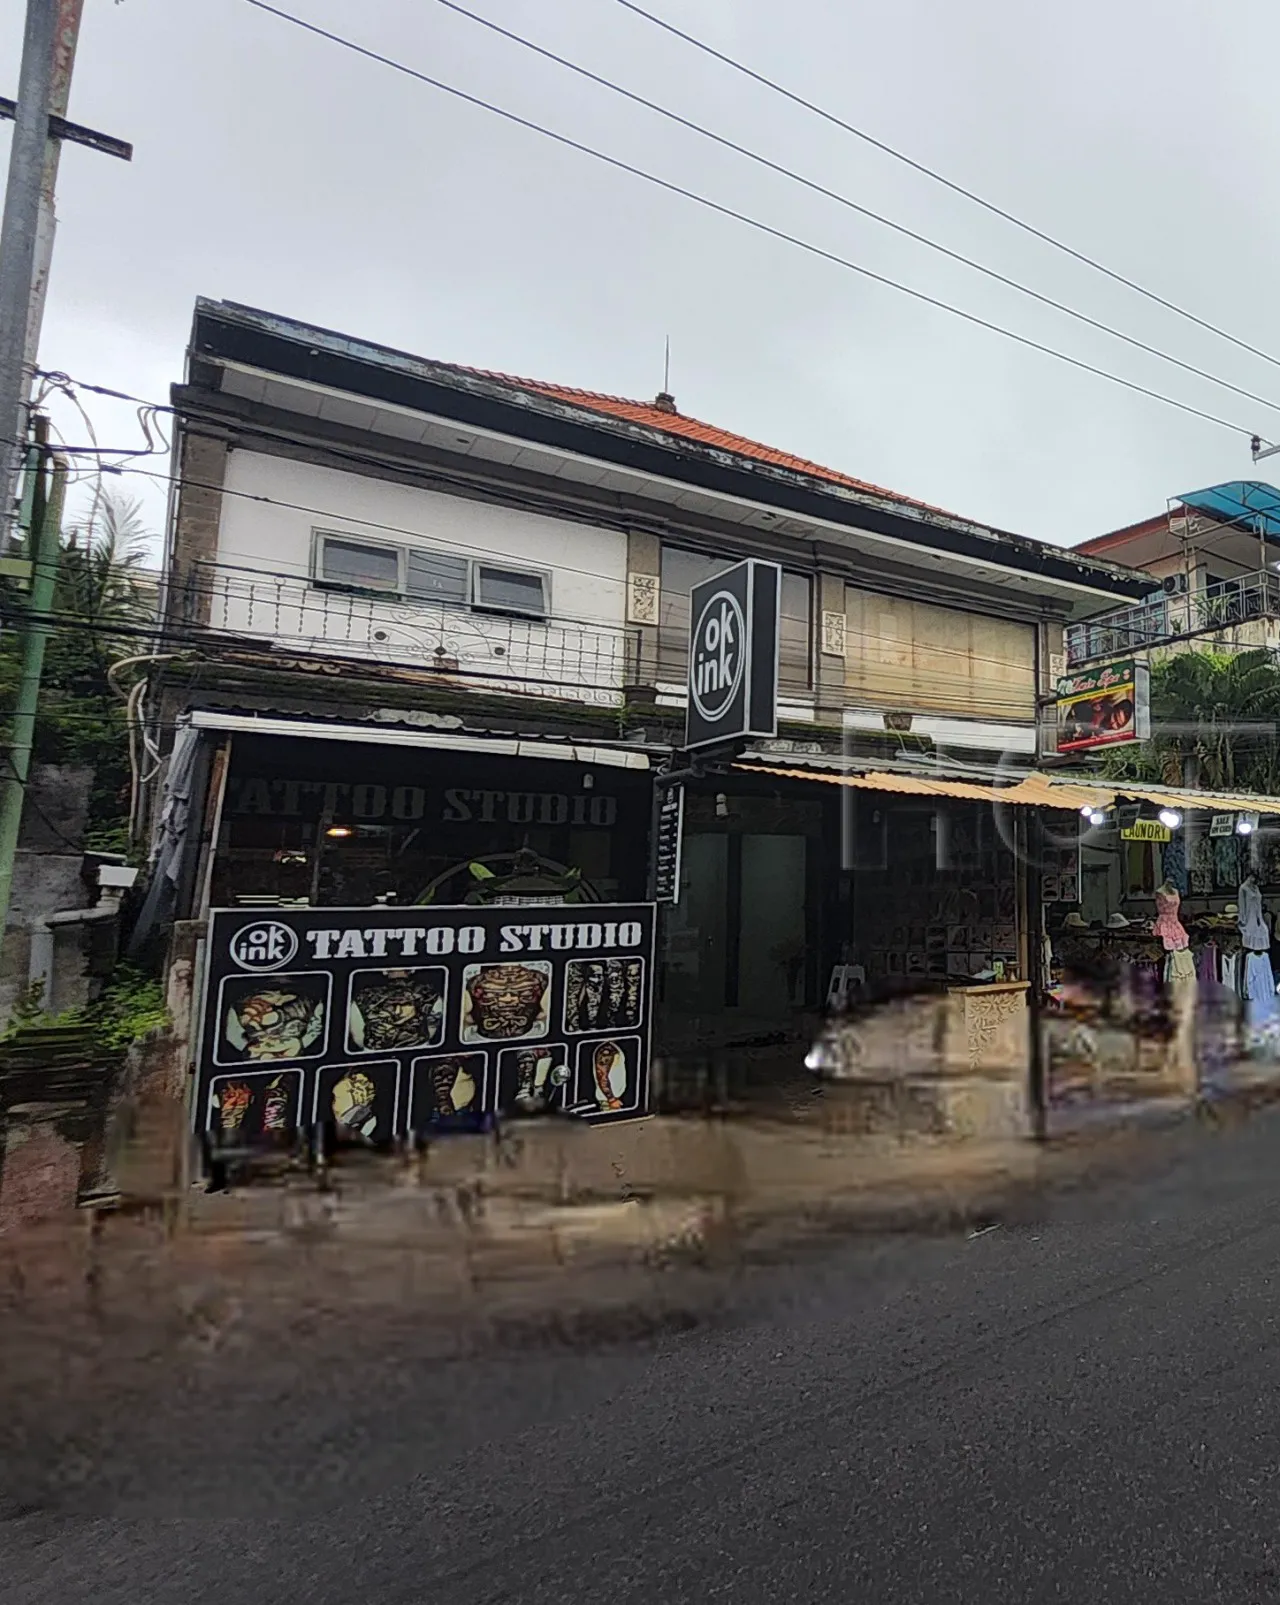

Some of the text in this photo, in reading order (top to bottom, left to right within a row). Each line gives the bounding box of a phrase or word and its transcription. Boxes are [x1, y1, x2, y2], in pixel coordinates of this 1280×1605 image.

[704, 602, 735, 652] ok
[697, 650, 734, 696] ink
[443, 787, 618, 825] STUDIO
[239, 940, 285, 960] ink
[249, 926, 285, 944] ok
[305, 922, 643, 959] TATTOO STUDIO
